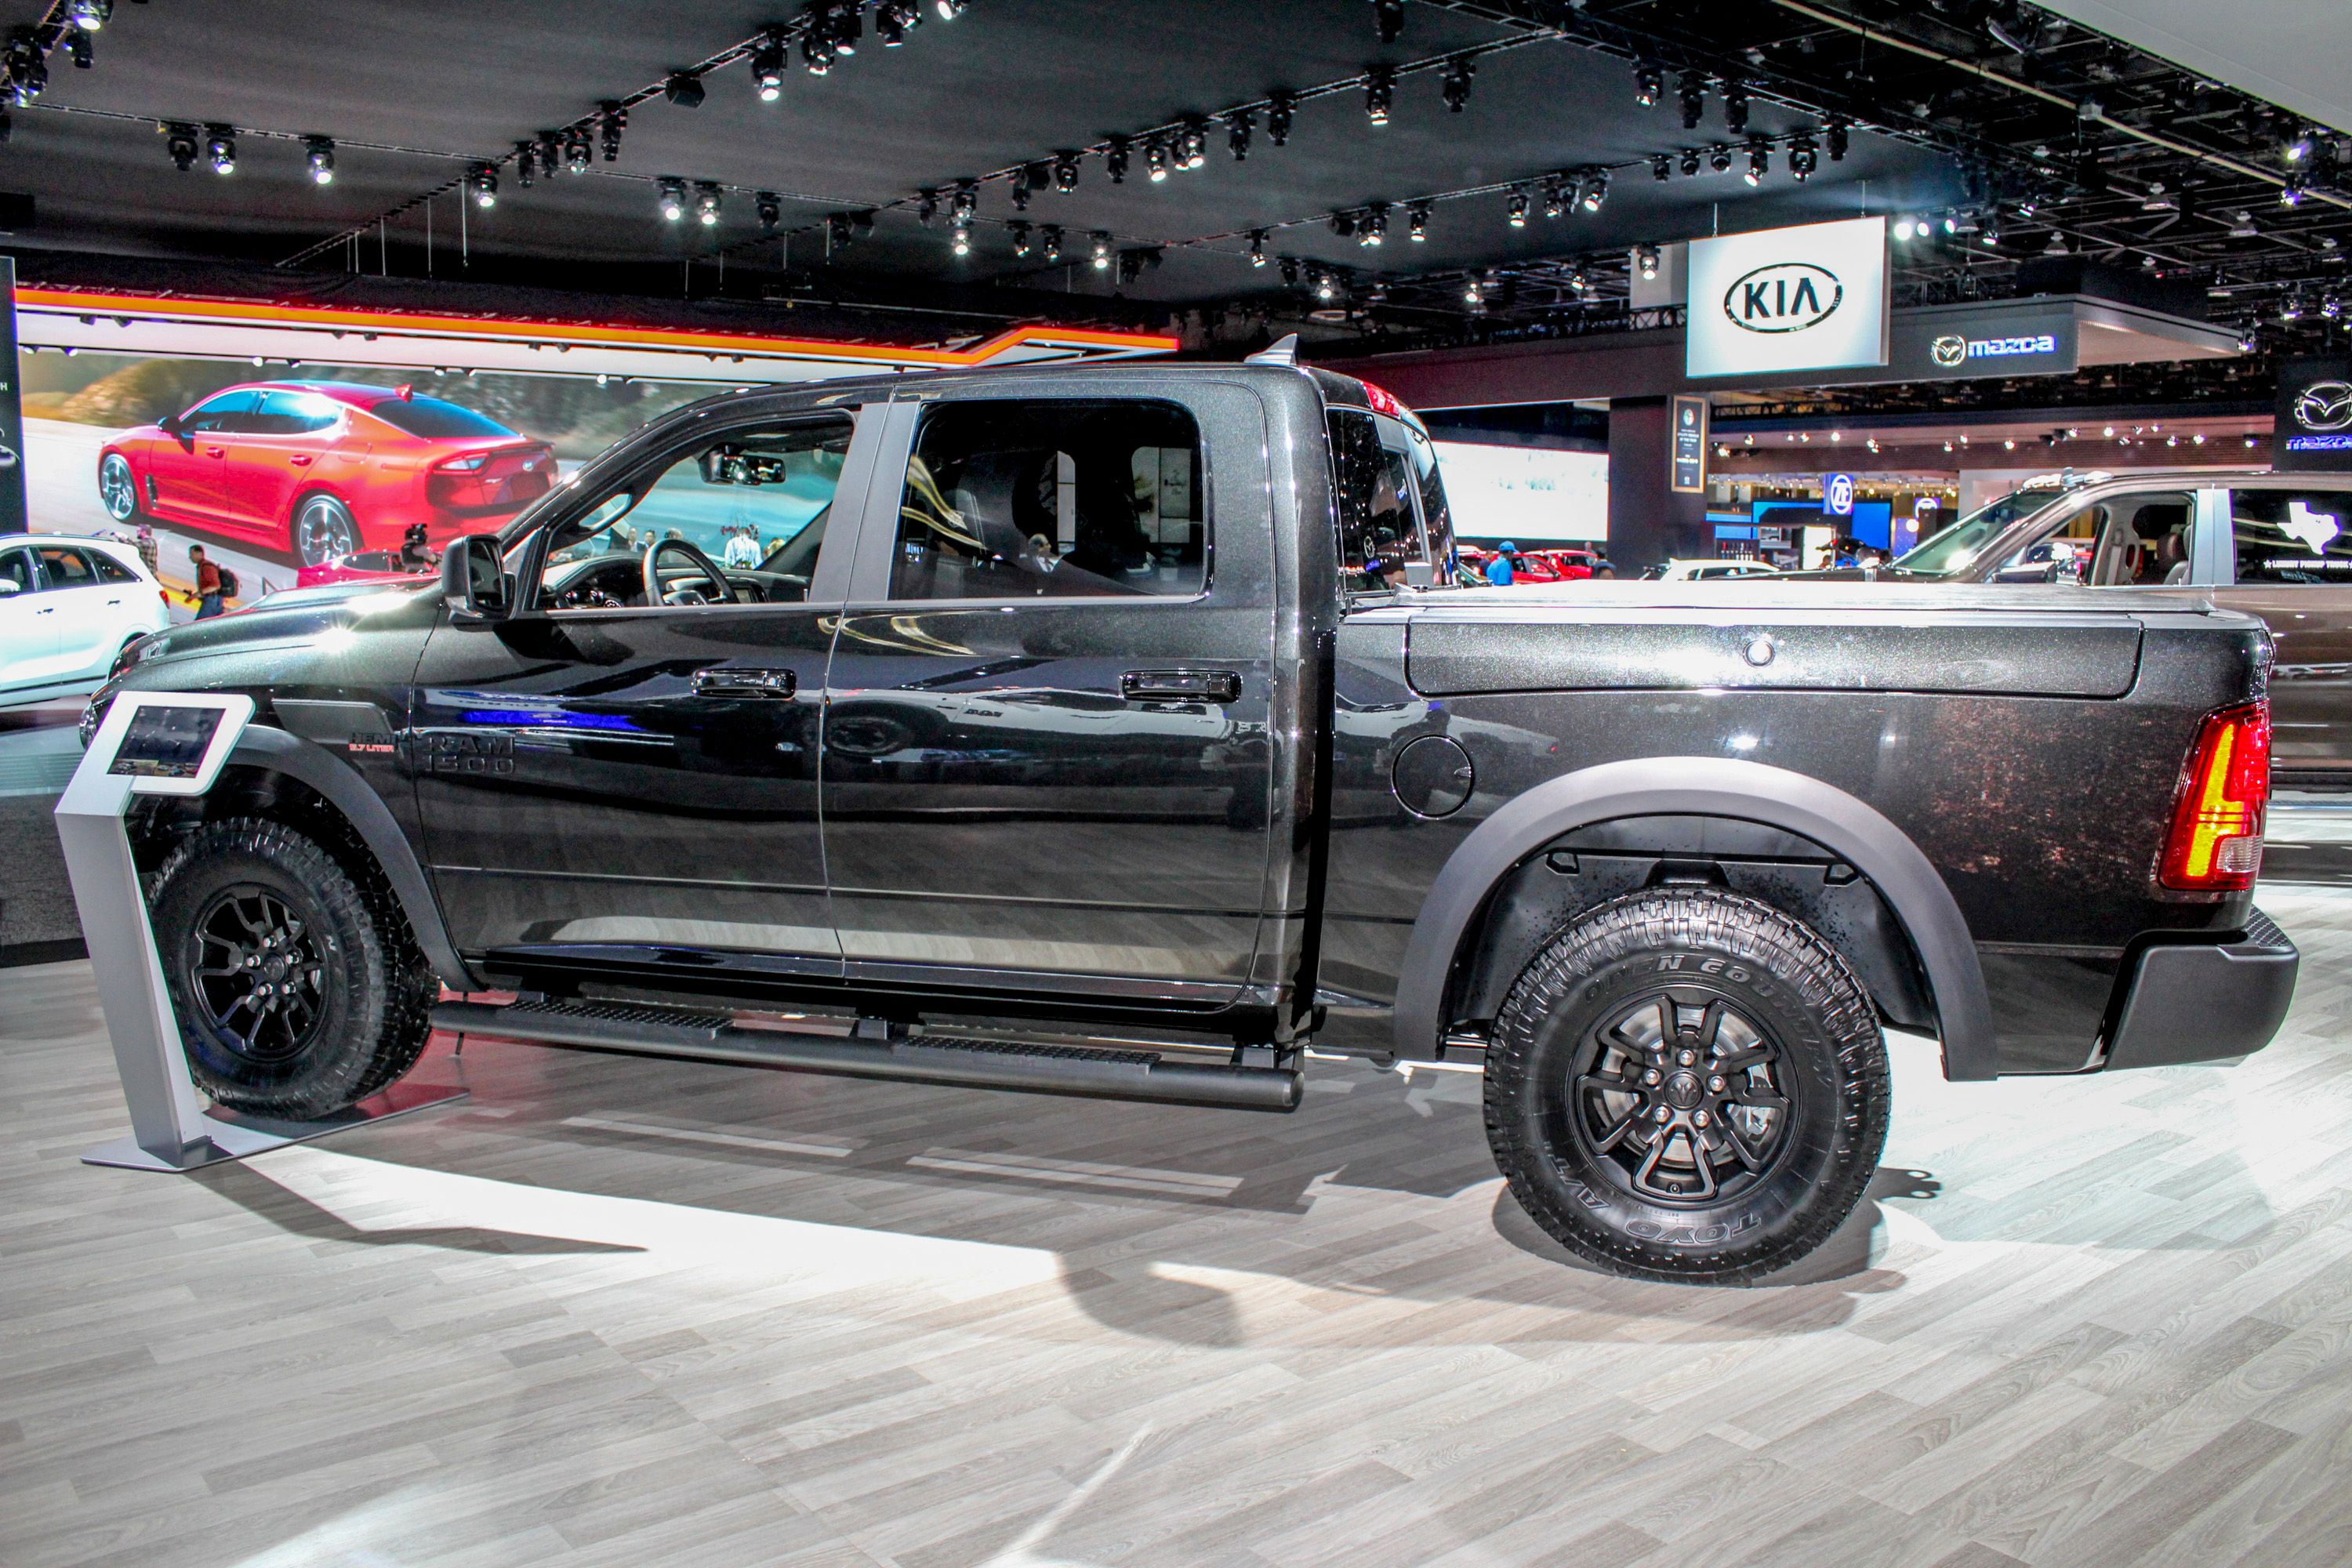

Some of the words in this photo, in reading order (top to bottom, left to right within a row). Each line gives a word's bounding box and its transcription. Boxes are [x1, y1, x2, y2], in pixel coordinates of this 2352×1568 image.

[1744, 277, 1820, 320] KIA
[1967, 335, 2056, 358] mazda
[423, 735, 515, 753] RAM
[424, 754, 515, 775] 1500
[1626, 1213, 1762, 1244] TOYO
